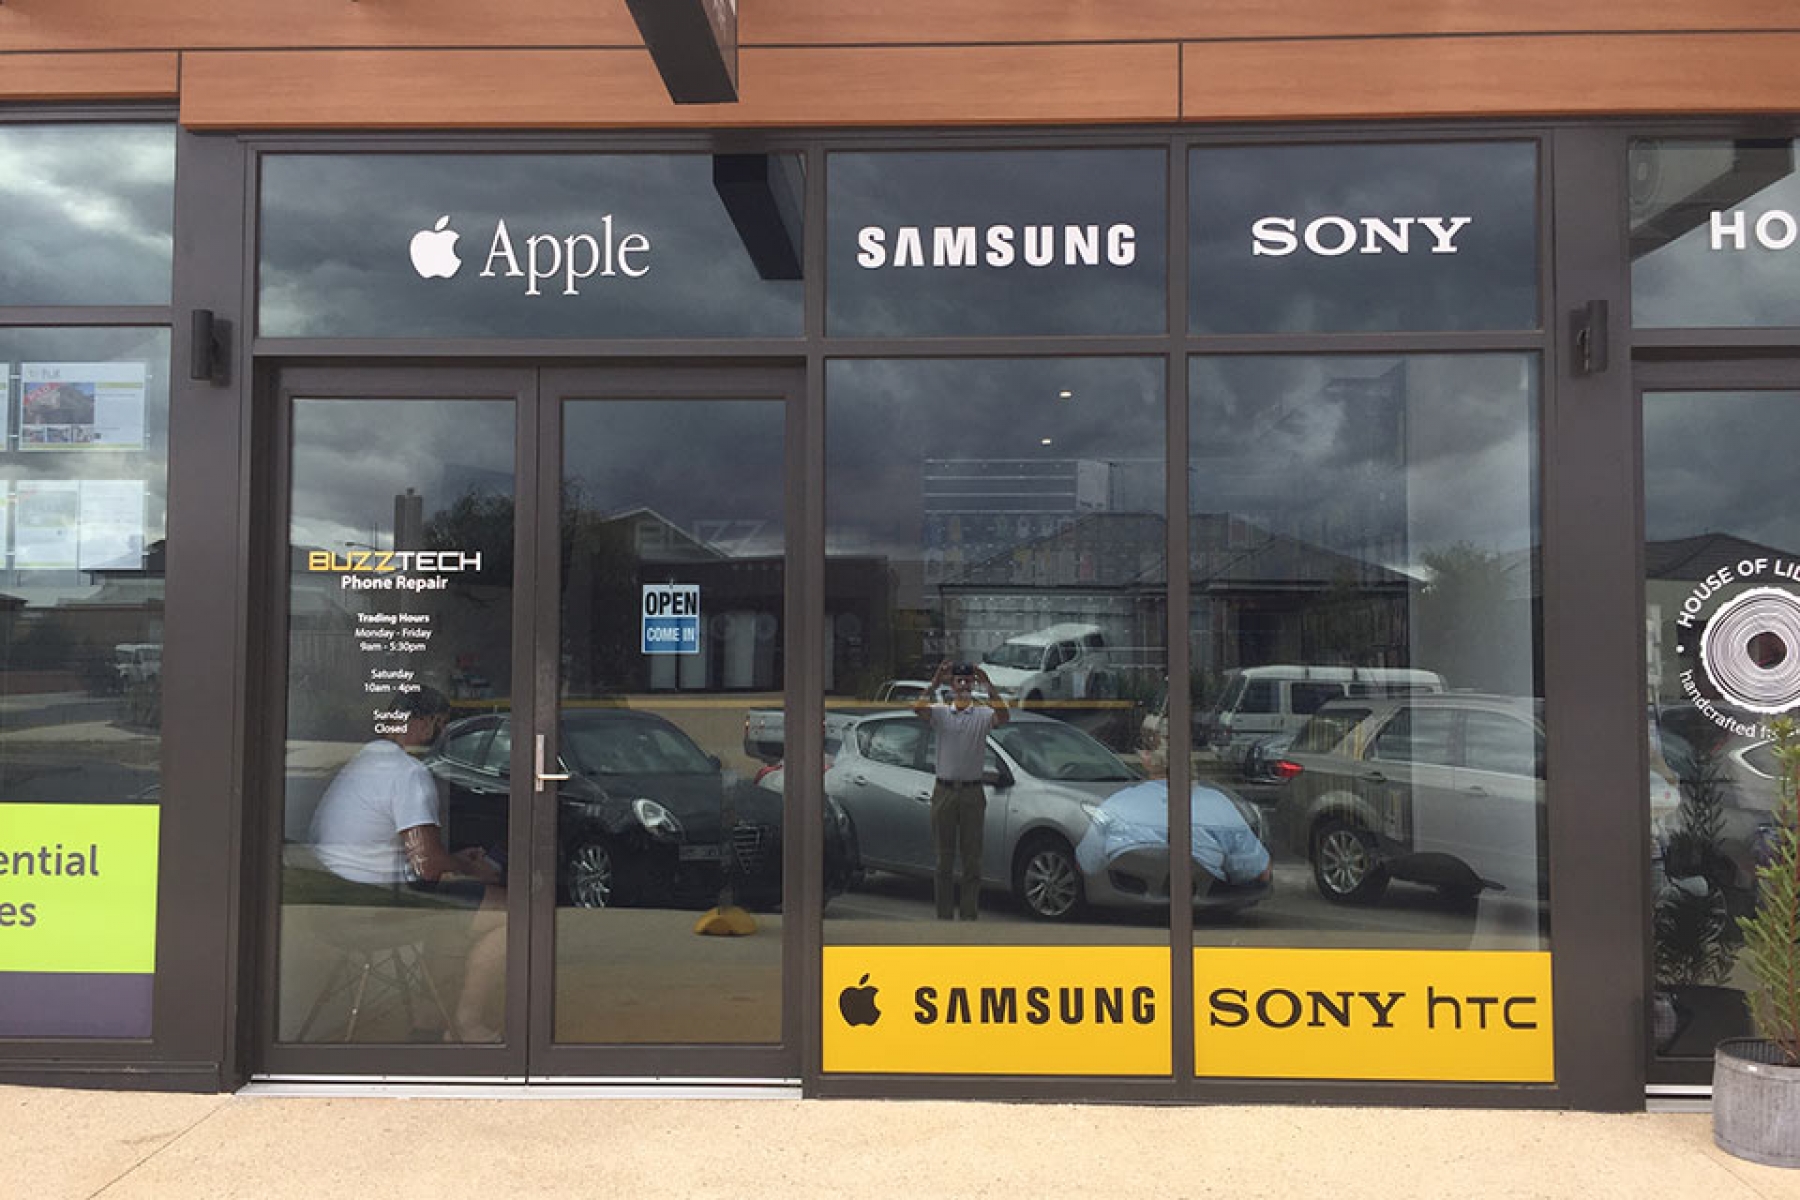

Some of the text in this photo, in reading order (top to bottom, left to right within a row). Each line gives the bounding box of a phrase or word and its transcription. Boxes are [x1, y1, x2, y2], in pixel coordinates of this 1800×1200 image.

[1252, 216, 1472, 256] SONY
[480, 214, 650, 295] Apple
[857, 223, 1136, 269] SAMSUNG
[308, 551, 482, 571] BUZZTECH
[341, 576, 449, 592] Phone Repair
[1677, 566, 1734, 628] HOUSE
[1738, 558, 1768, 576] OF
[646, 592, 697, 615] OPEN
[358, 613, 430, 624] Trading Hours
[354, 628, 395, 639] Monday
[403, 628, 433, 639] Friday
[647, 627, 680, 641] COME
[682, 627, 695, 641] IN
[360, 641, 382, 651] 9am
[371, 669, 415, 680] Saturday
[364, 683, 391, 692] 10am
[399, 683, 420, 694] 4pm
[1680, 669, 1756, 738] handcrafted
[373, 710, 411, 721] Sunday
[375, 723, 408, 733] Closed
[915, 986, 1155, 1025] SAMSUNG
[1209, 988, 1406, 1028] SONY
